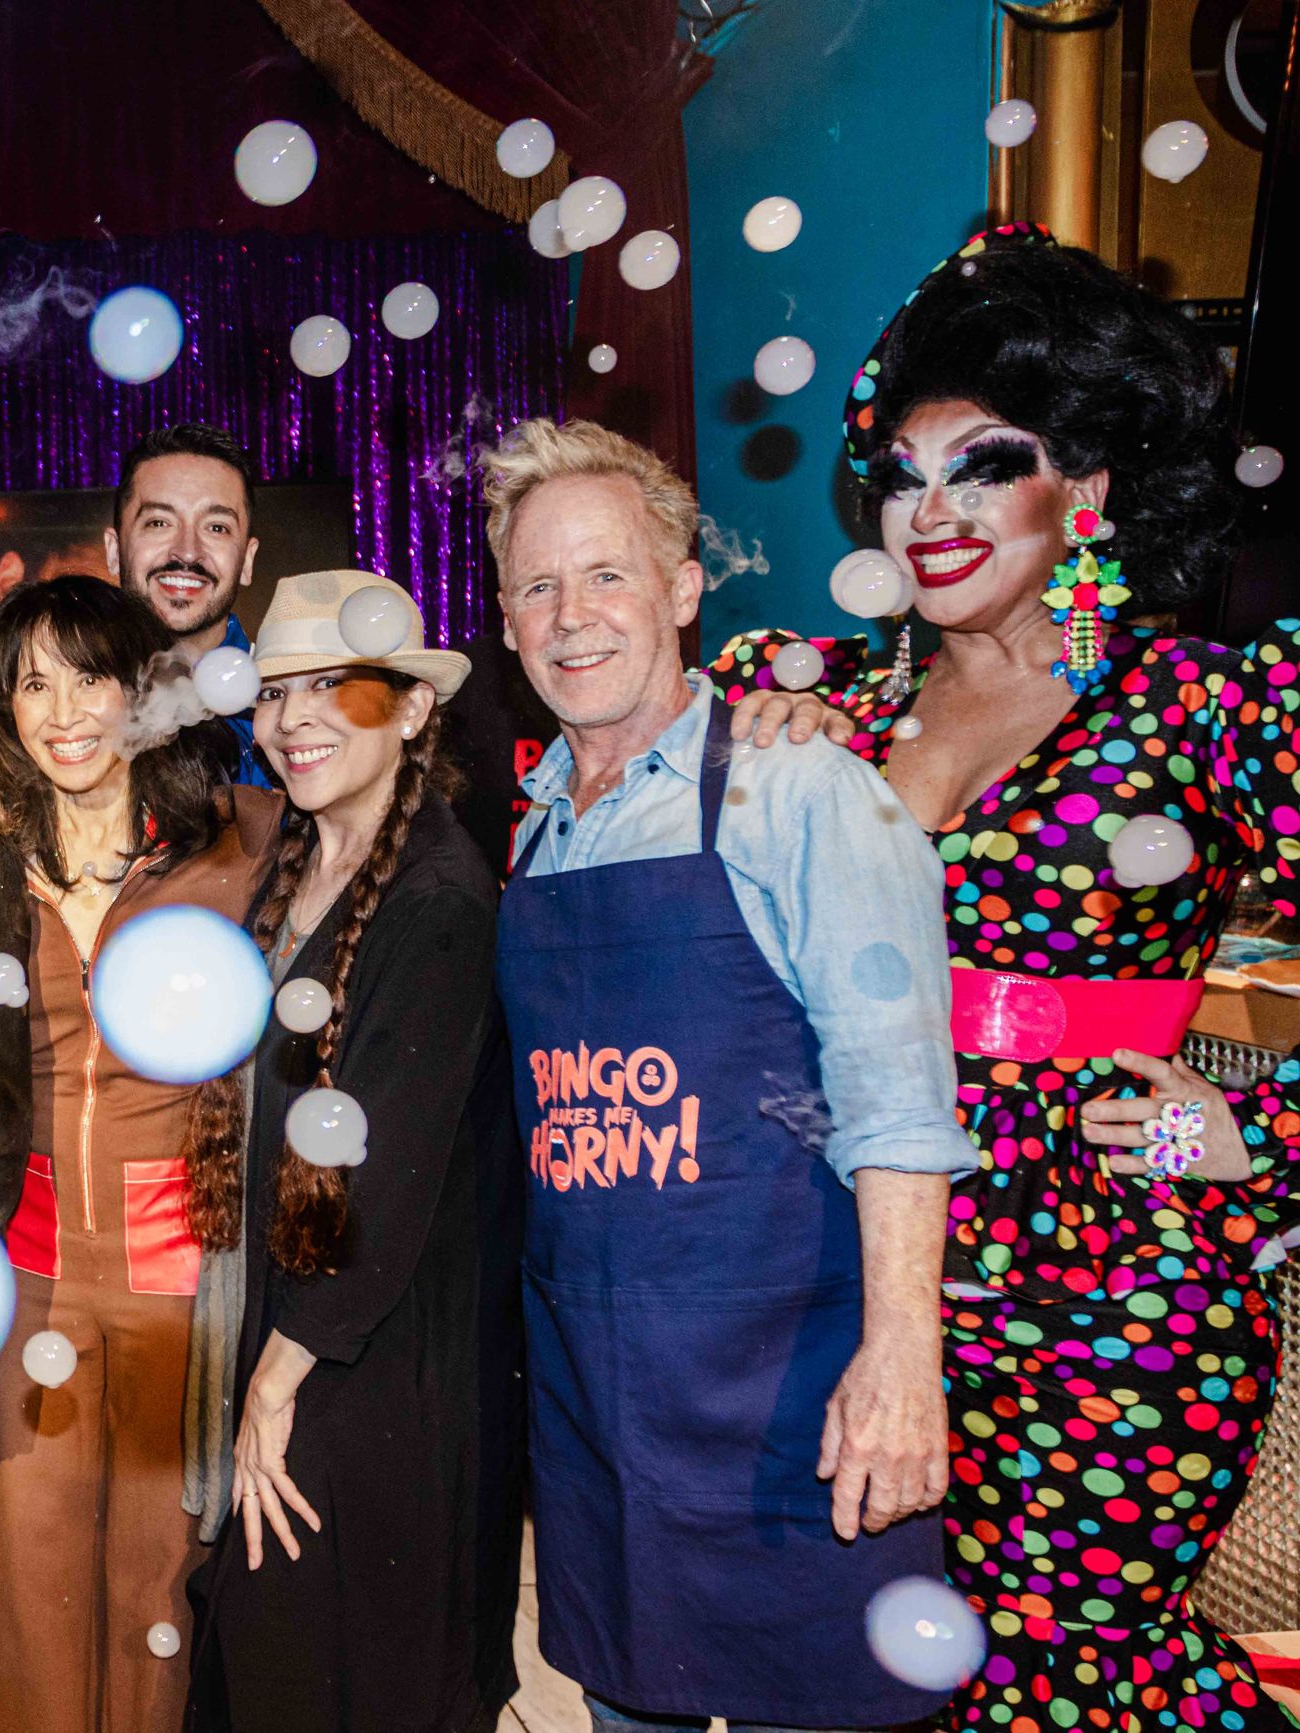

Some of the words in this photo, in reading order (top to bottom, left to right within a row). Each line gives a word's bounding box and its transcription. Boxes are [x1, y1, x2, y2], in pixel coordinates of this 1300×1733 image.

[529, 1040, 678, 1110] BINGO
[530, 1094, 700, 1193] HORNY!
[549, 1106, 598, 1127] MAKES
[604, 1105, 634, 1127] ME
